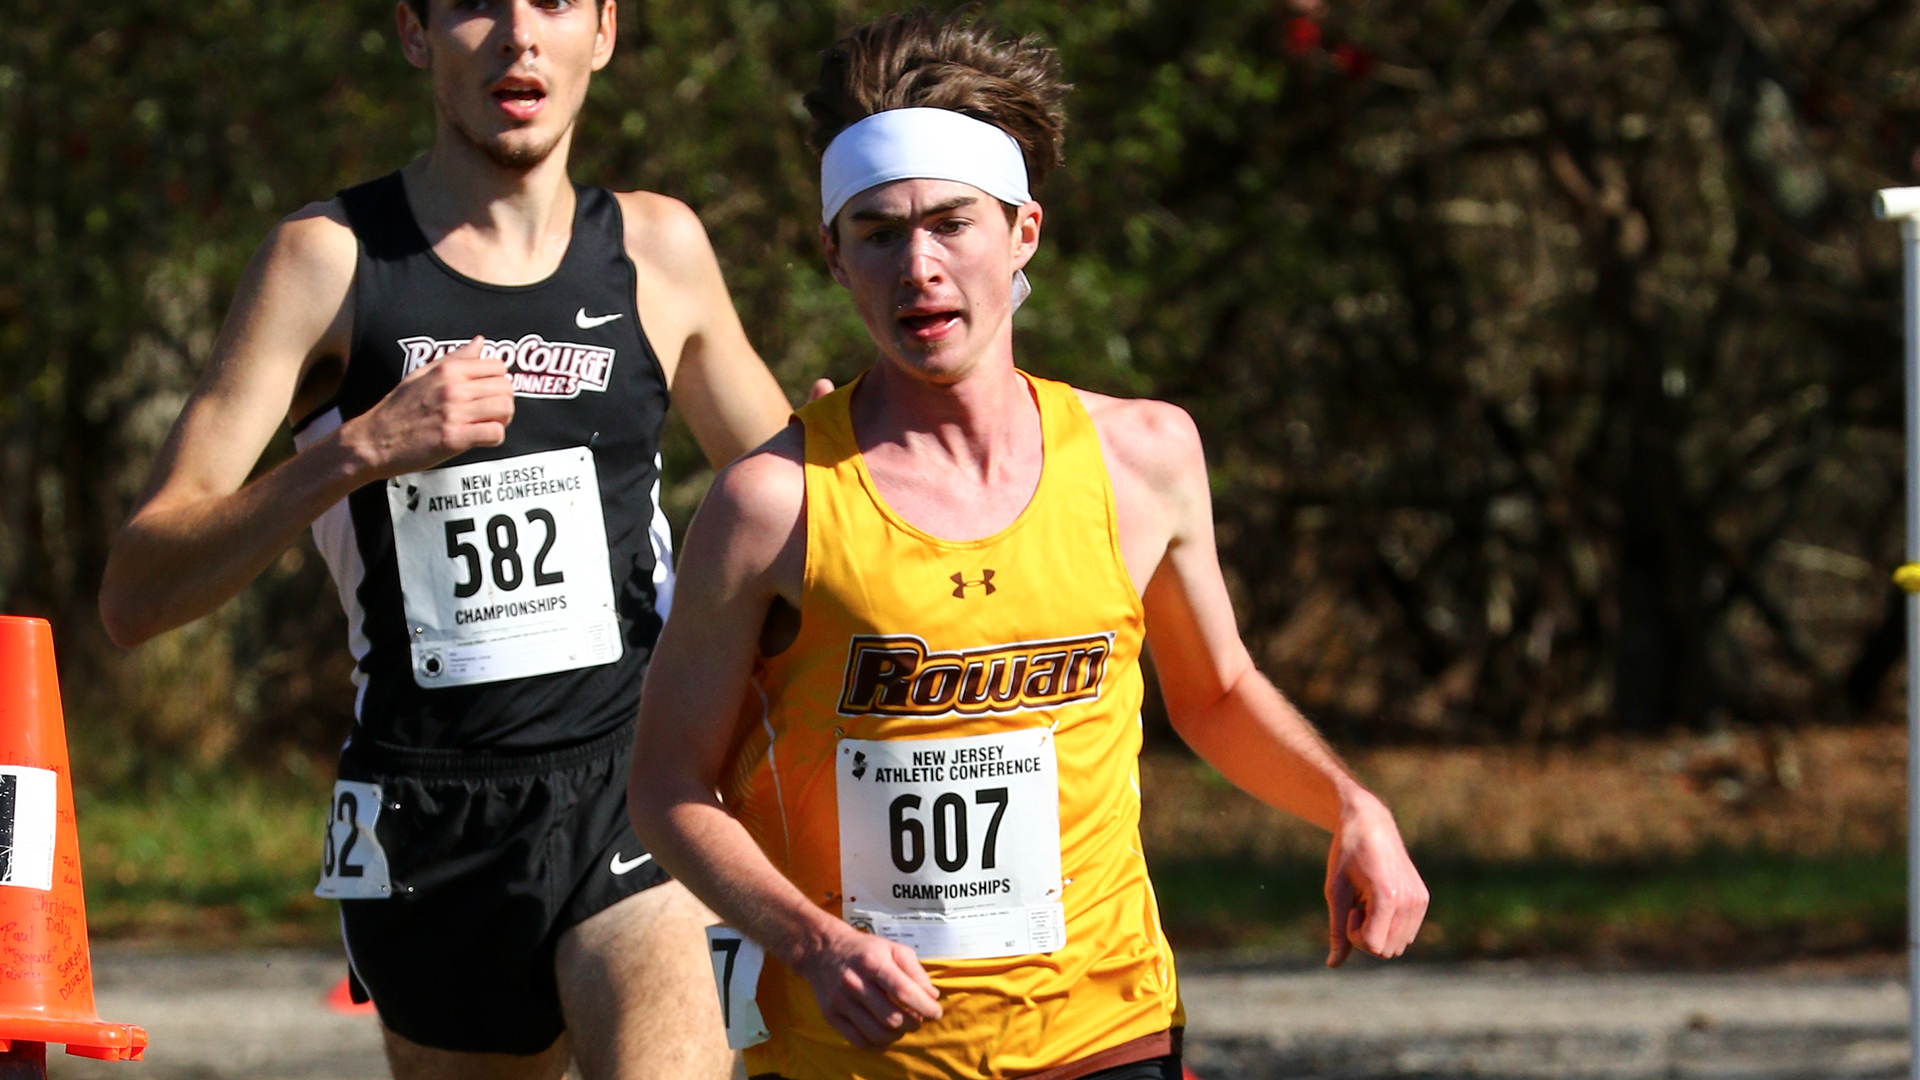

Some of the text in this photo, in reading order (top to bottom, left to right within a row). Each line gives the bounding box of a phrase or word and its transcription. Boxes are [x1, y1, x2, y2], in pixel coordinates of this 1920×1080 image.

[405, 339, 610, 386] RAPO COLLEGE
[428, 475, 582, 512] ATHLETIC CONFERENCE
[460, 465, 546, 492] NEW JERSEY
[444, 507, 565, 599] 582
[455, 595, 568, 625] CHAMPIONSHIPS
[845, 640, 1109, 711] Rowan
[875, 757, 1042, 783] ATHLETIC CONFERENCE
[912, 745, 1005, 767] NEW JERSEY
[888, 786, 1009, 874] 607
[892, 877, 1011, 900] CHAMPIONSHIPS
[31, 894, 78, 920] Christine
[0, 921, 34, 944] Paul
[46, 917, 73, 950] Daly
[57, 943, 84, 978] SARAH
